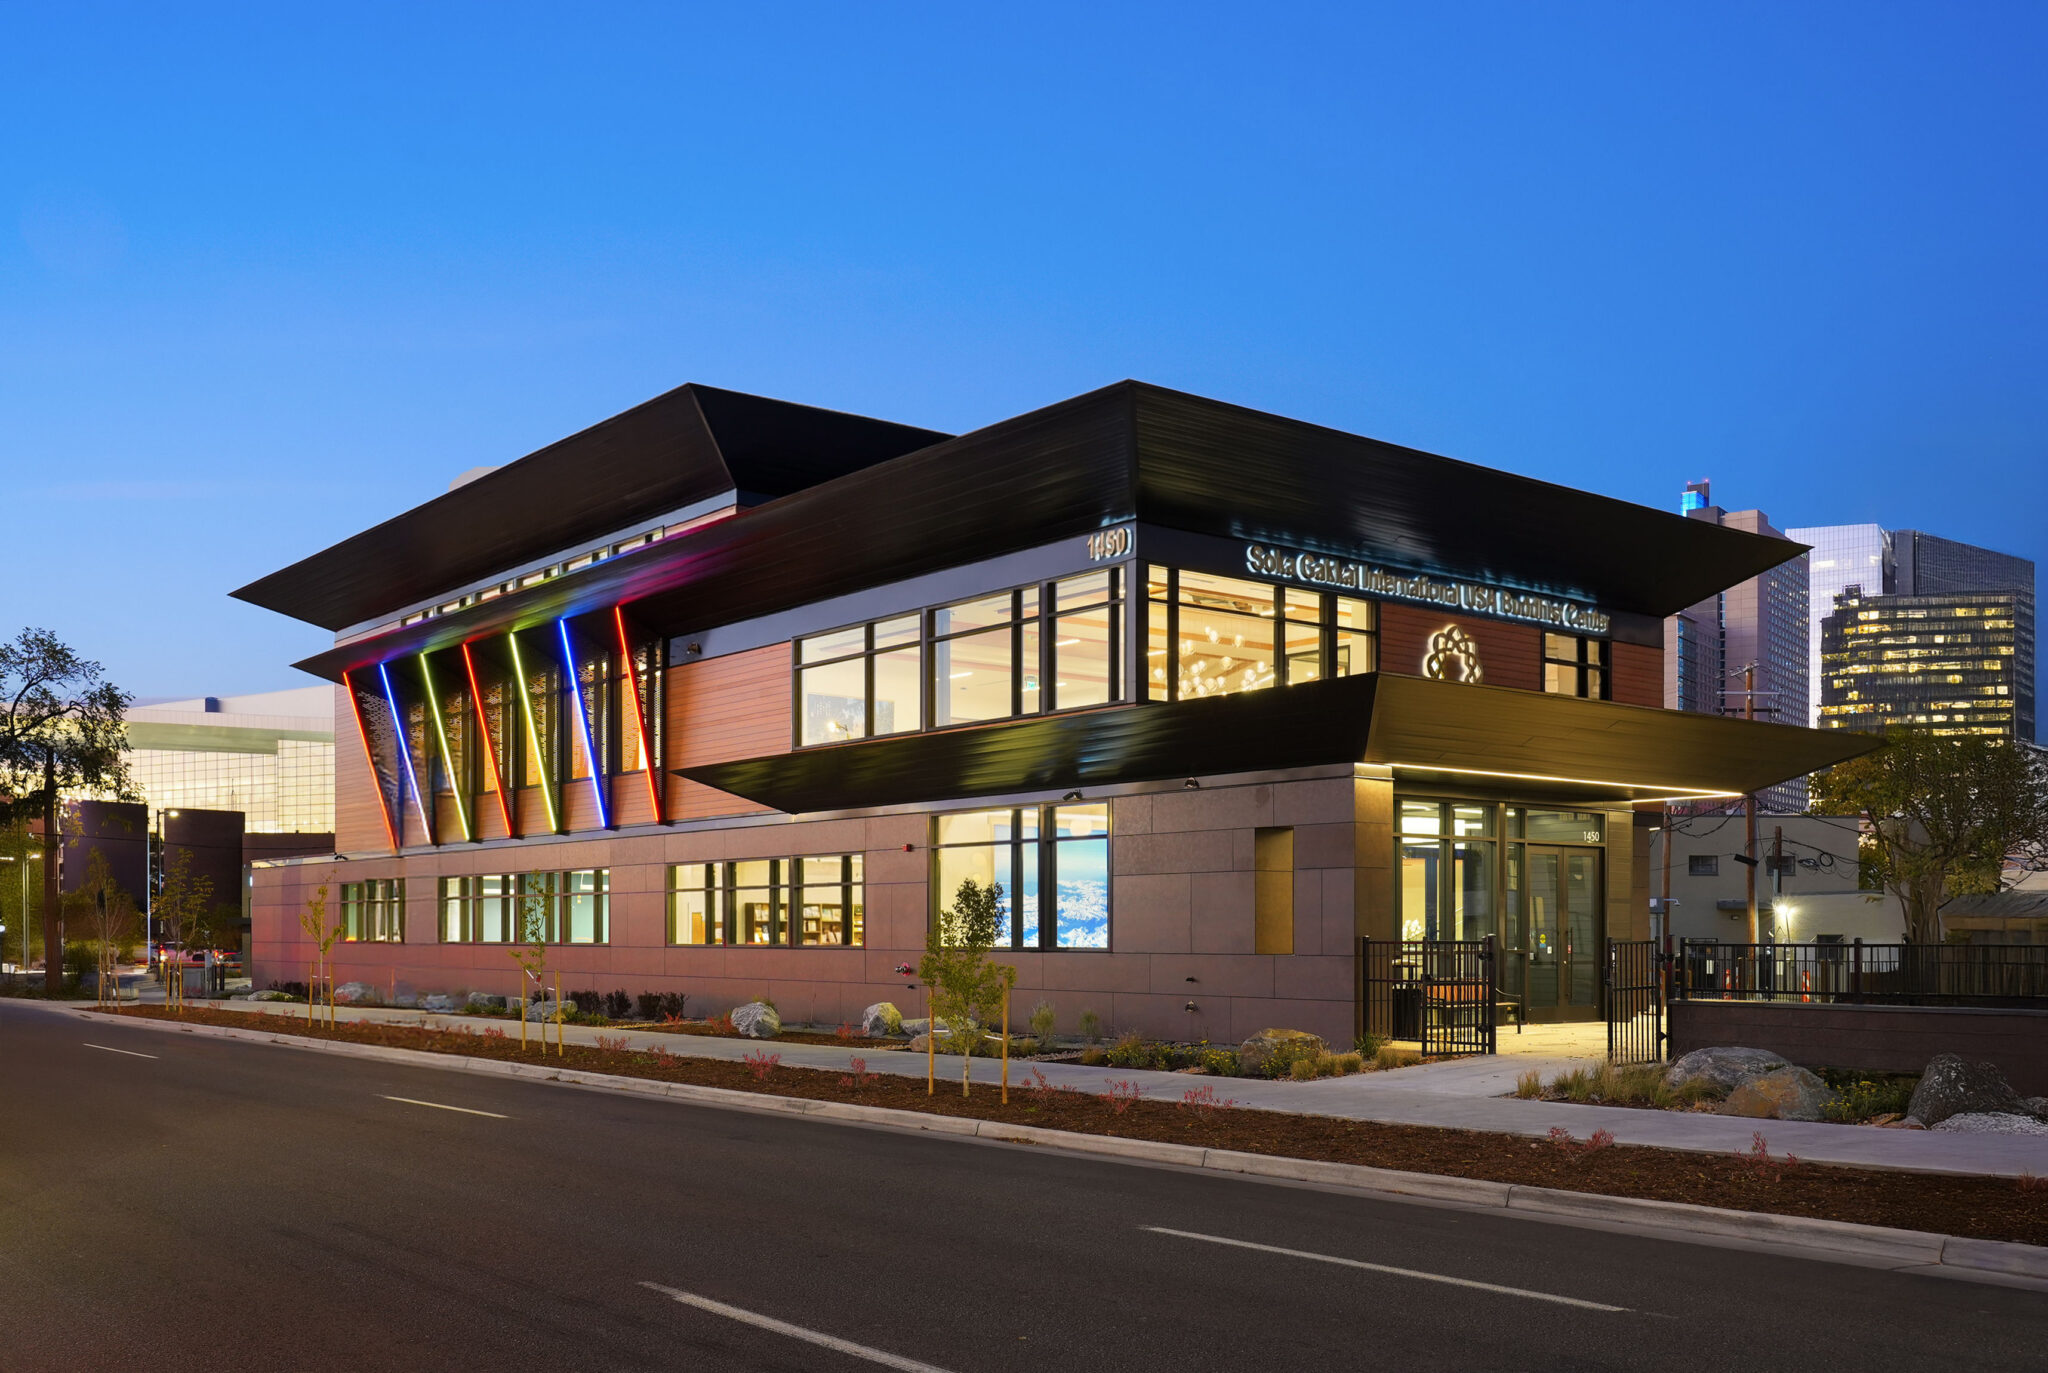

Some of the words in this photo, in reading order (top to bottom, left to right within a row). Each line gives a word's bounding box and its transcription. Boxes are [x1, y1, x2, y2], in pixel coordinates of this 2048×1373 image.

[1087, 527, 1132, 561] 1450
[1246, 545, 1295, 578] Soka
[1296, 553, 1357, 588] Gakkai
[1359, 565, 1459, 606] International
[1460, 583, 1496, 614] USA
[1496, 591, 1562, 625] Buddhist
[1563, 604, 1609, 632] Center
[1583, 831, 1600, 842] 1450
